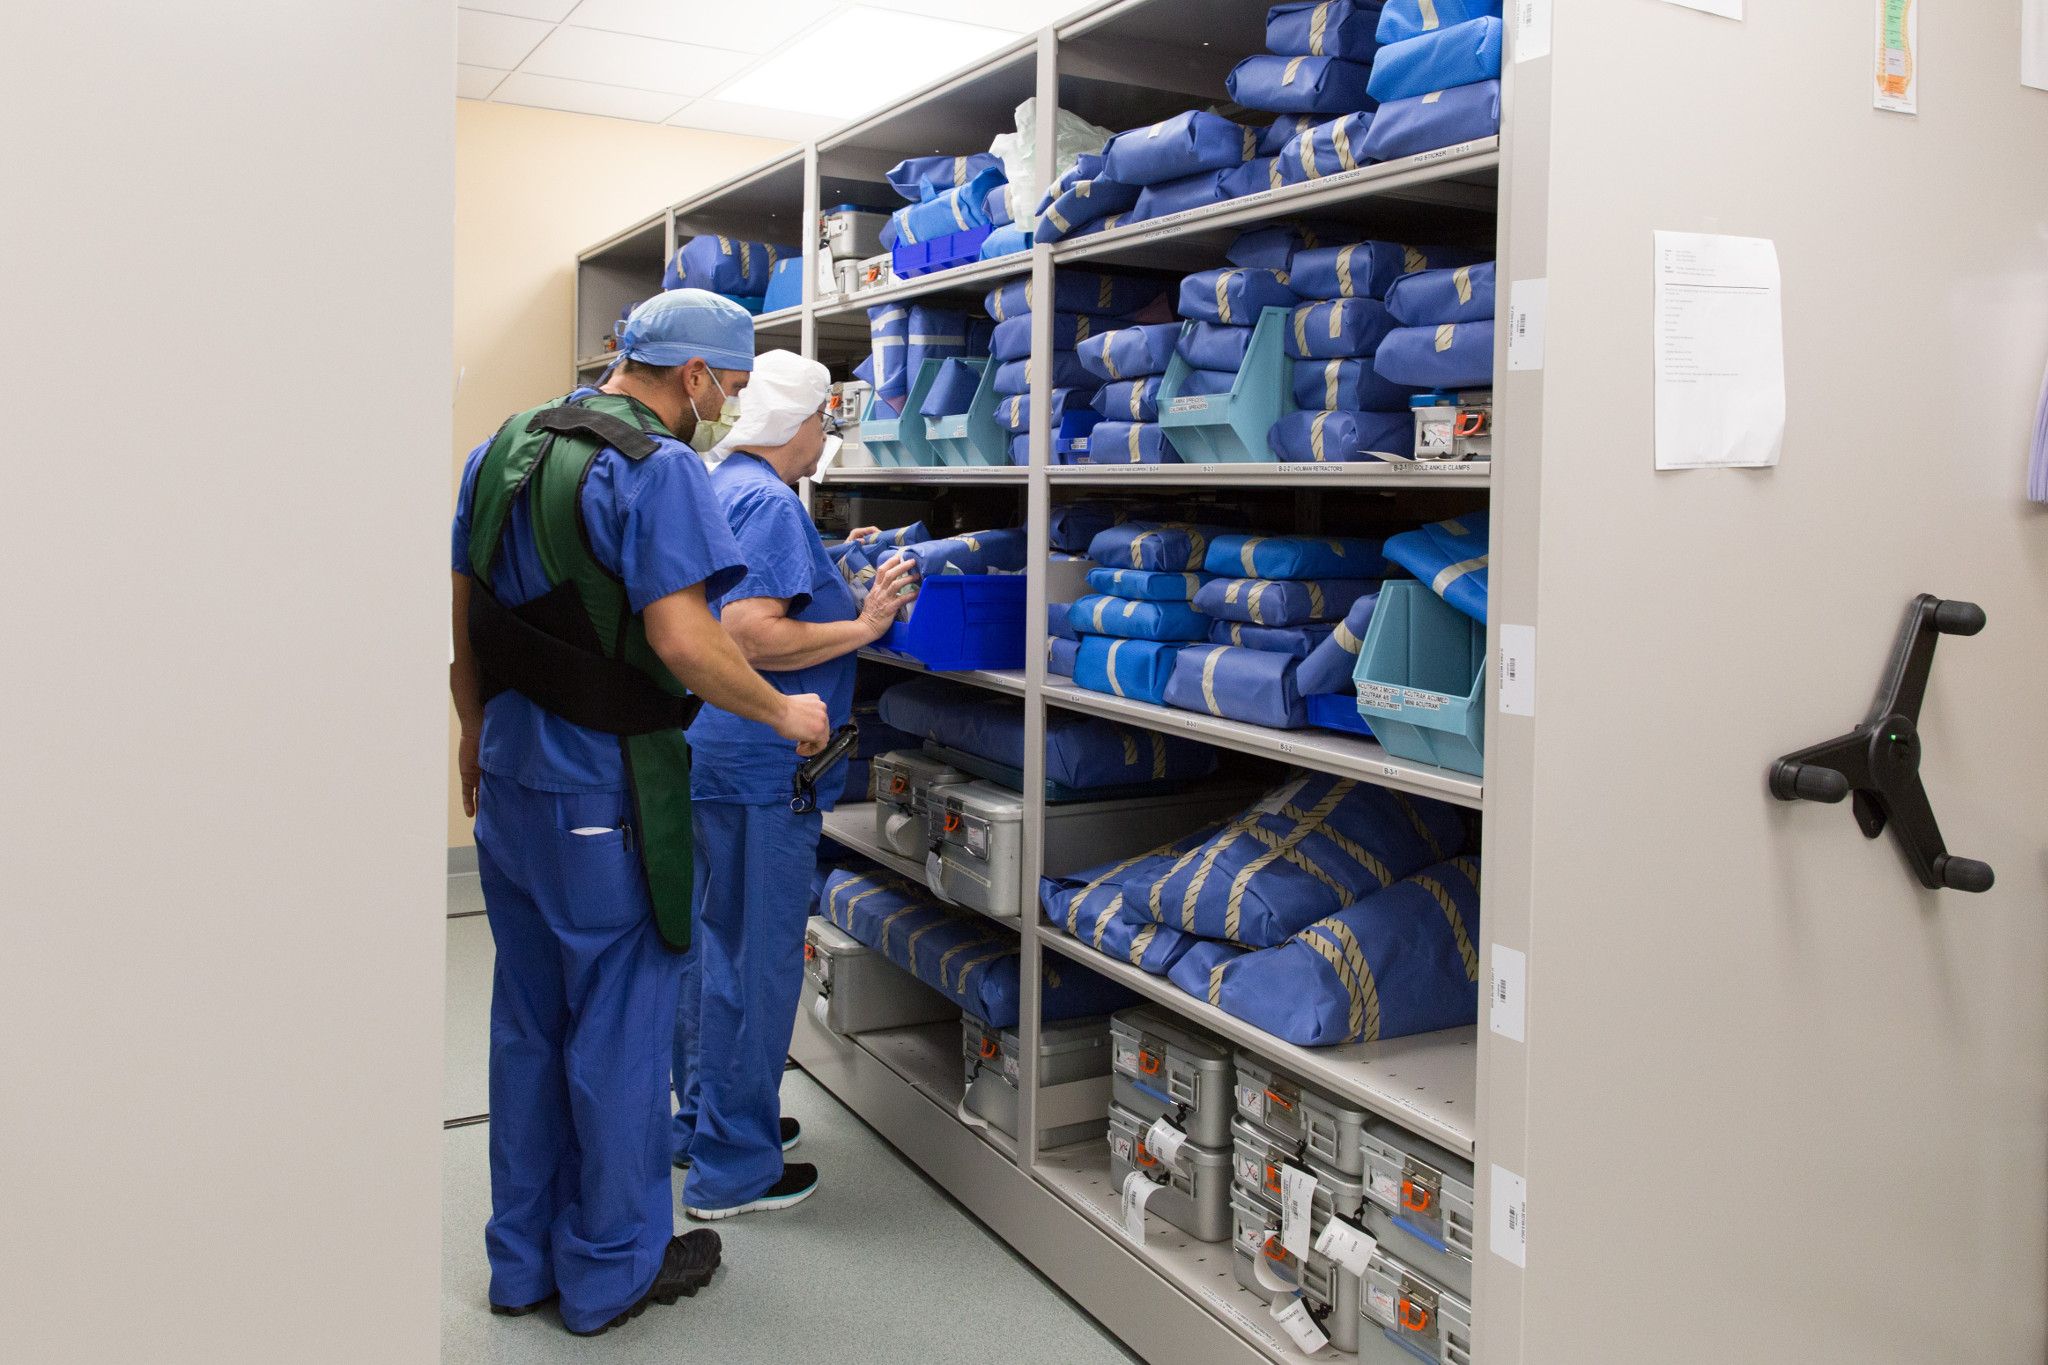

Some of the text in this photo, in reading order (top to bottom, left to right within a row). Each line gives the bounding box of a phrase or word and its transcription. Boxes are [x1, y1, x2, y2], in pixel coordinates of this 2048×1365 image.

[1424, 150, 1447, 160] STICKER
[1358, 684, 1378, 692] ACUTRAK
[1383, 687, 1398, 695] MICRO
[1361, 691, 1381, 699] ACUTRAK
[1404, 690, 1426, 698] ACUTRAK
[1416, 701, 1438, 709] ACUTRAK
[1384, 768, 1398, 776] B-3-1
